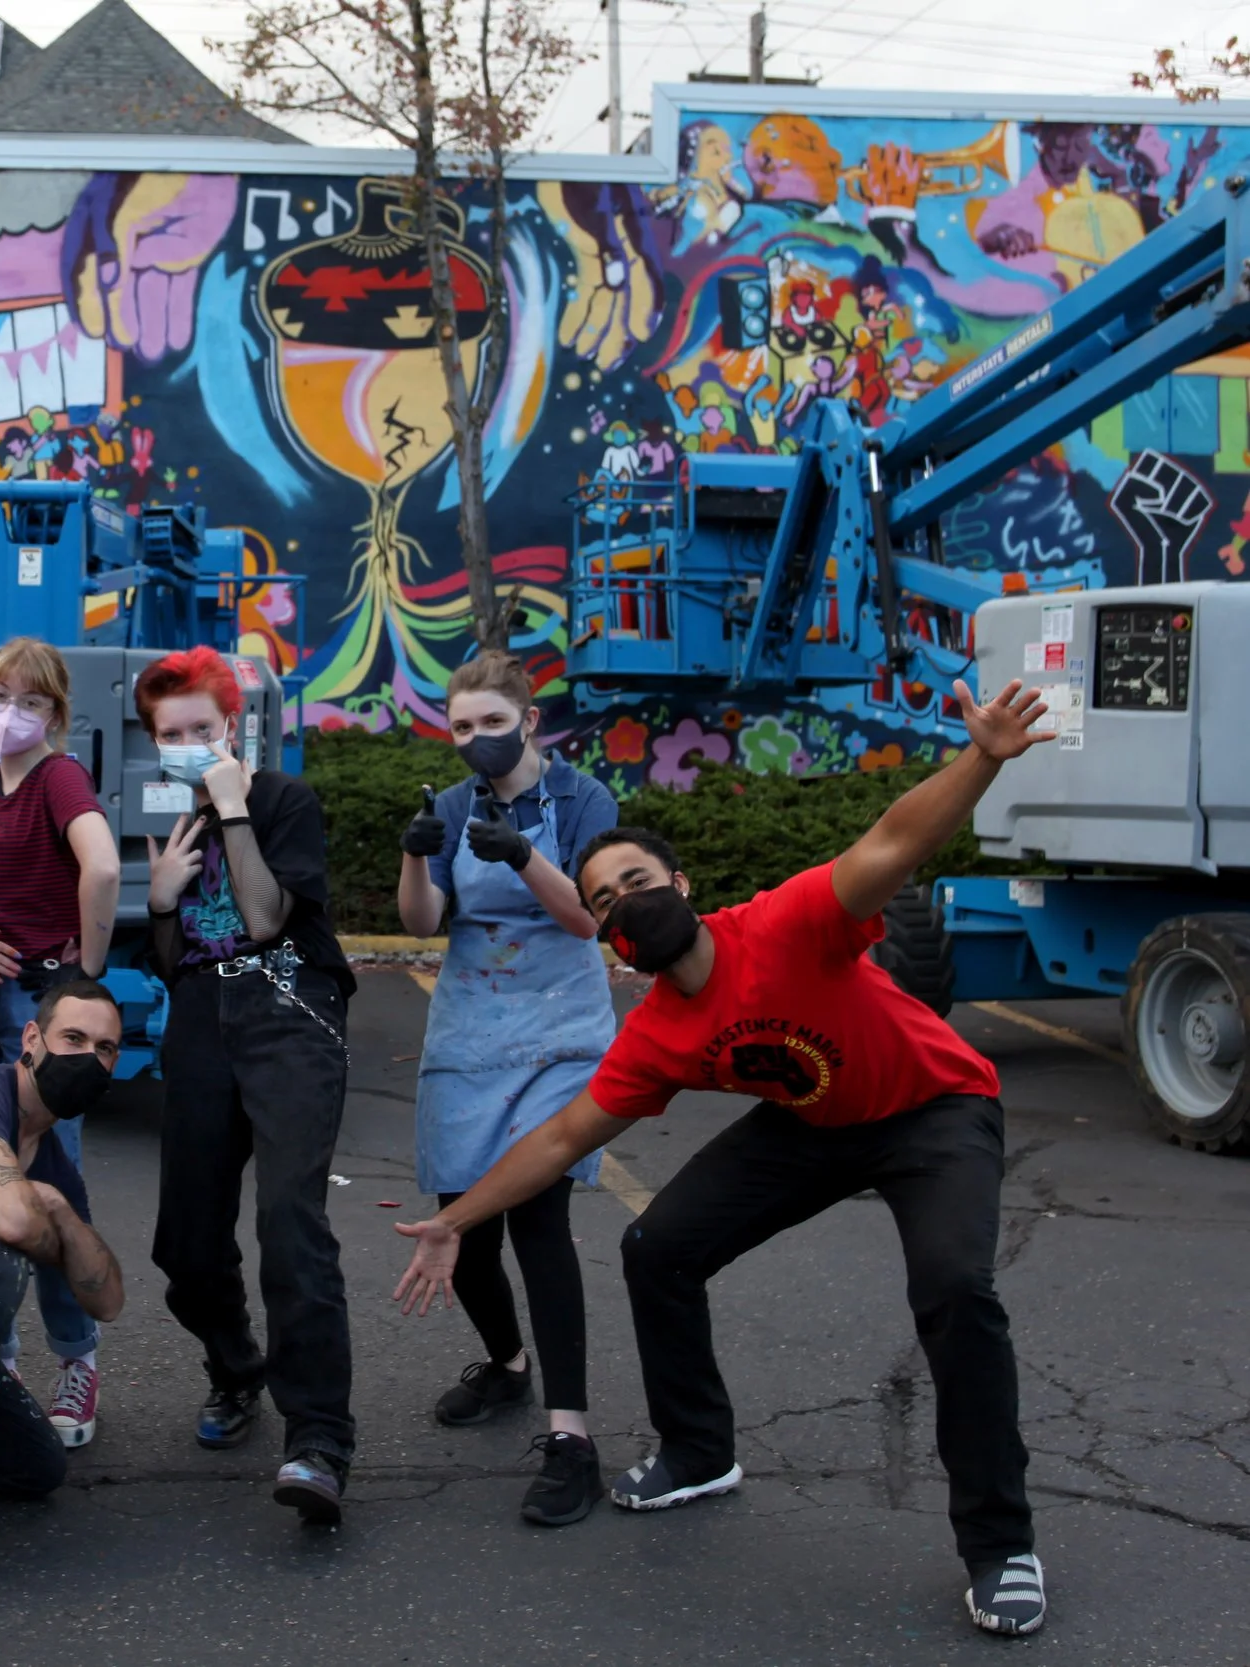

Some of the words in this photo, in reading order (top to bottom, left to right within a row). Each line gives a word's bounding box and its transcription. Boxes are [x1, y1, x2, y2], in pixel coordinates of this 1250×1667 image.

[951, 350, 1005, 396] INTERSTATE
[1005, 316, 1050, 359] RENTALS
[705, 1018, 791, 1057] EXISTENCE
